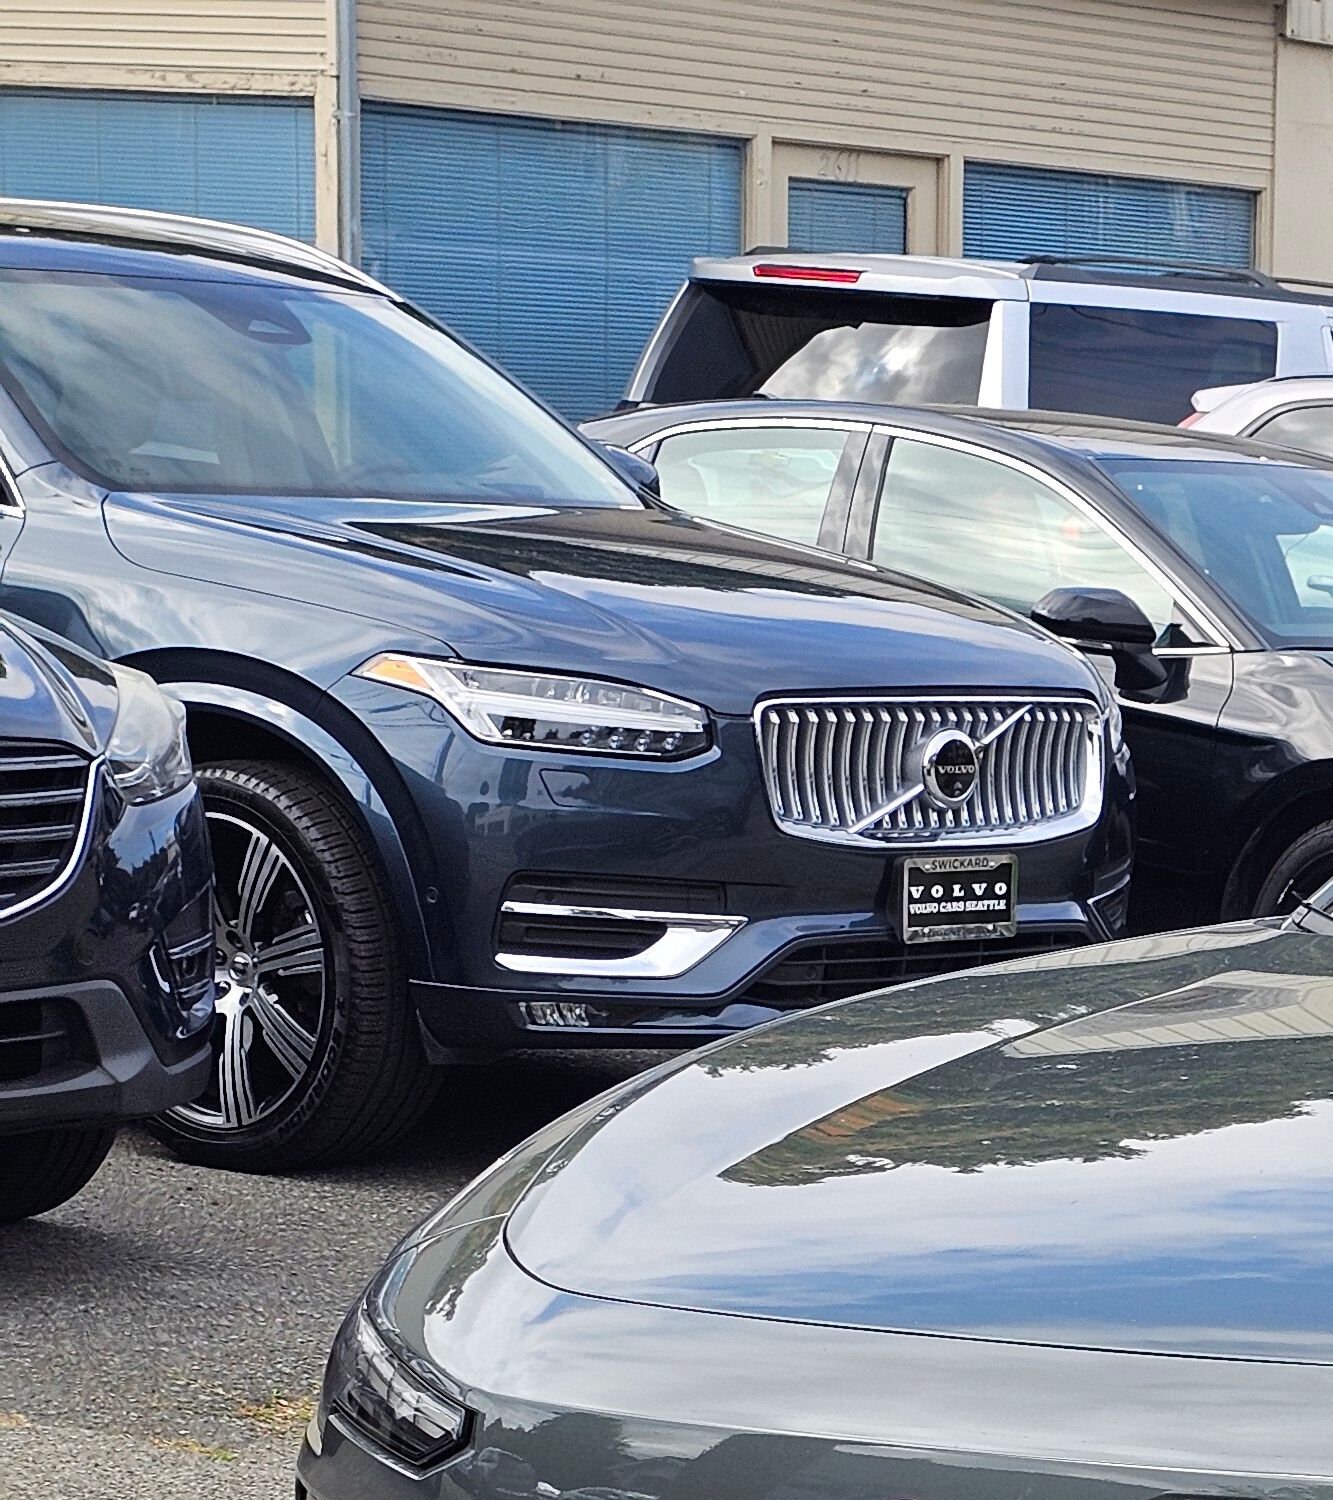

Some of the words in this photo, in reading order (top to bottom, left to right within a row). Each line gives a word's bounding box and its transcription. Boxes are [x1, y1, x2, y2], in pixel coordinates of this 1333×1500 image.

[937, 765, 975, 774] VOLVO
[931, 857, 989, 871] SWICKARD
[909, 882, 1007, 898] VOLVO
[909, 902, 939, 915] VOLVO
[939, 901, 965, 913] CARS
[965, 900, 1006, 911] SEATTLE
